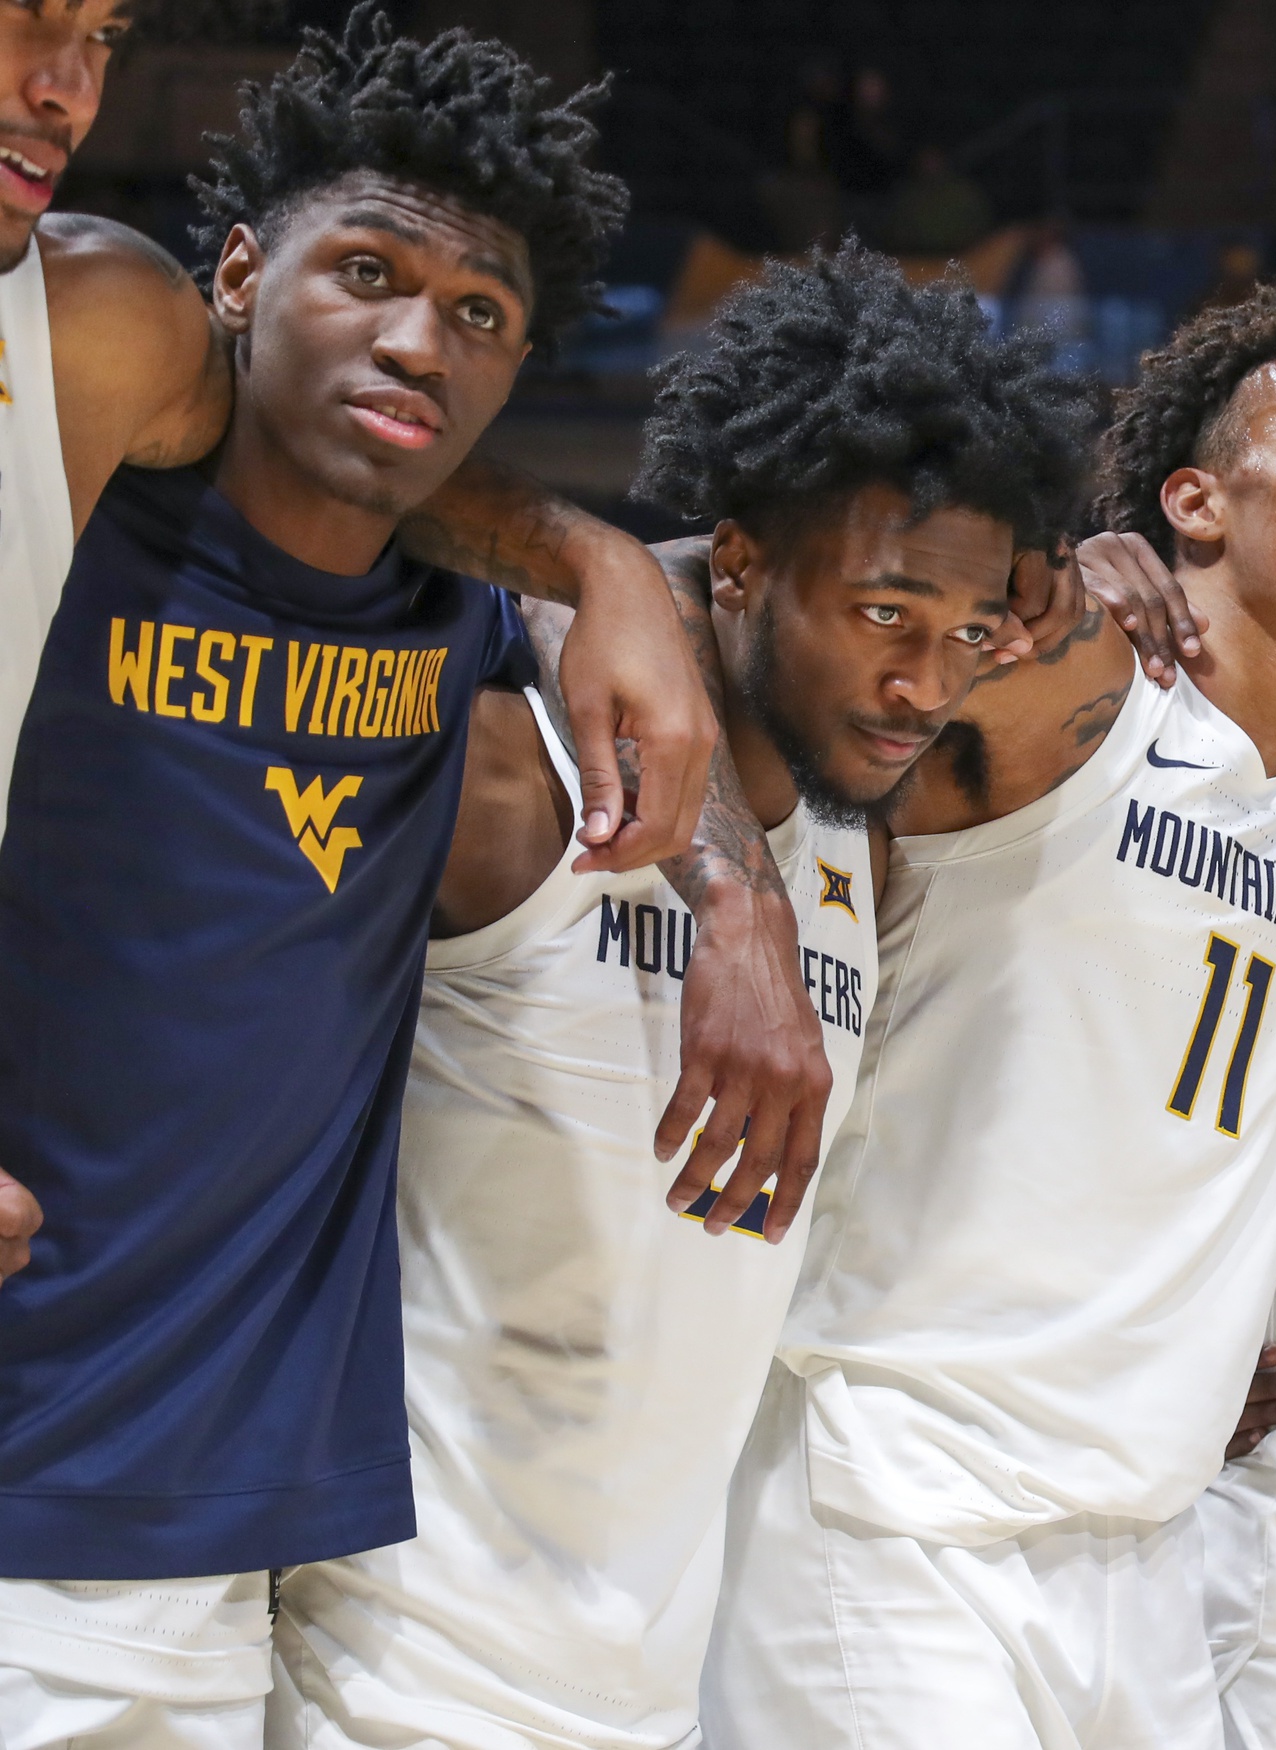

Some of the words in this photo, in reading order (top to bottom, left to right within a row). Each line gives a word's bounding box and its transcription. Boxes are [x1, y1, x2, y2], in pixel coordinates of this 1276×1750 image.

[108, 617, 273, 727] WEST
[284, 640, 448, 738] VIRGINIA
[1165, 930, 1276, 1140] 11
